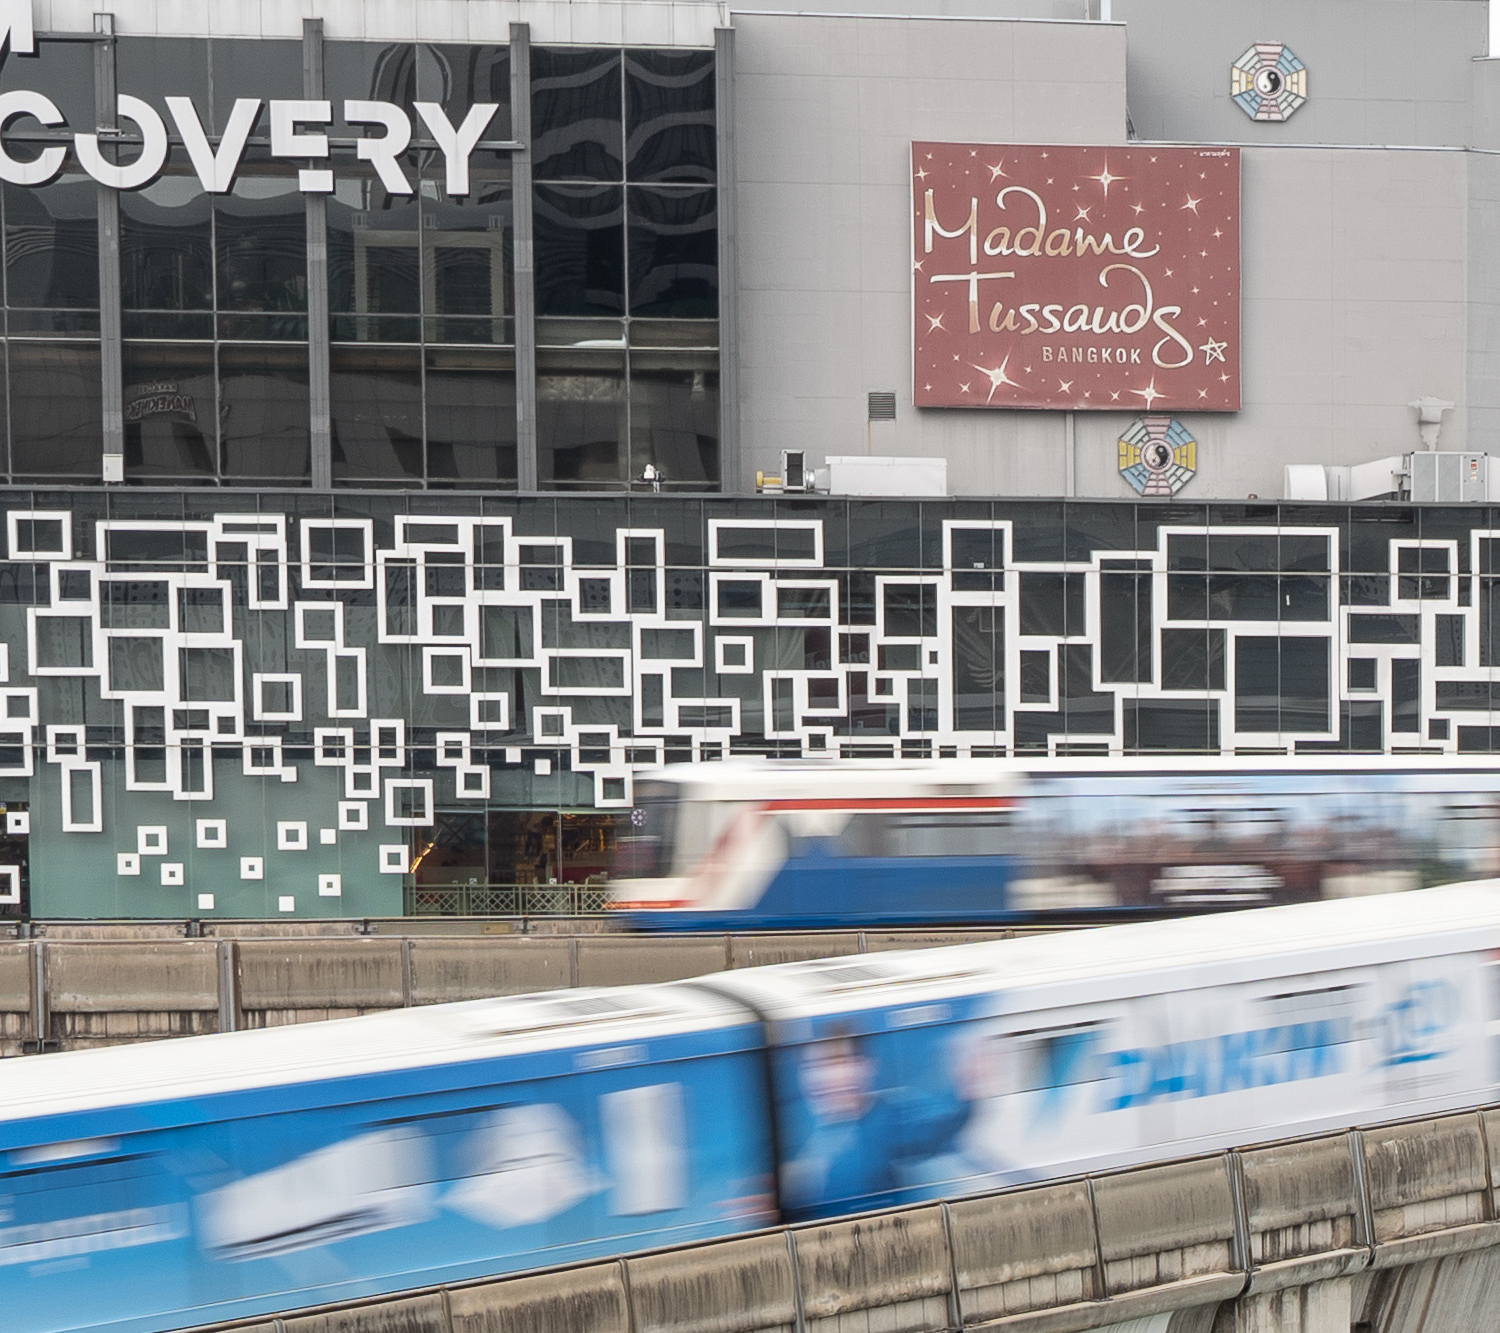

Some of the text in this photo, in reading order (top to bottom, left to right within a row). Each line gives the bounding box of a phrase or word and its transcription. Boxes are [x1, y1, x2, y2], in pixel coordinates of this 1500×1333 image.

[923, 186, 1160, 265] Madame
[930, 263, 1194, 369] Tussauds
[1042, 346, 1142, 365] BANGKOK
